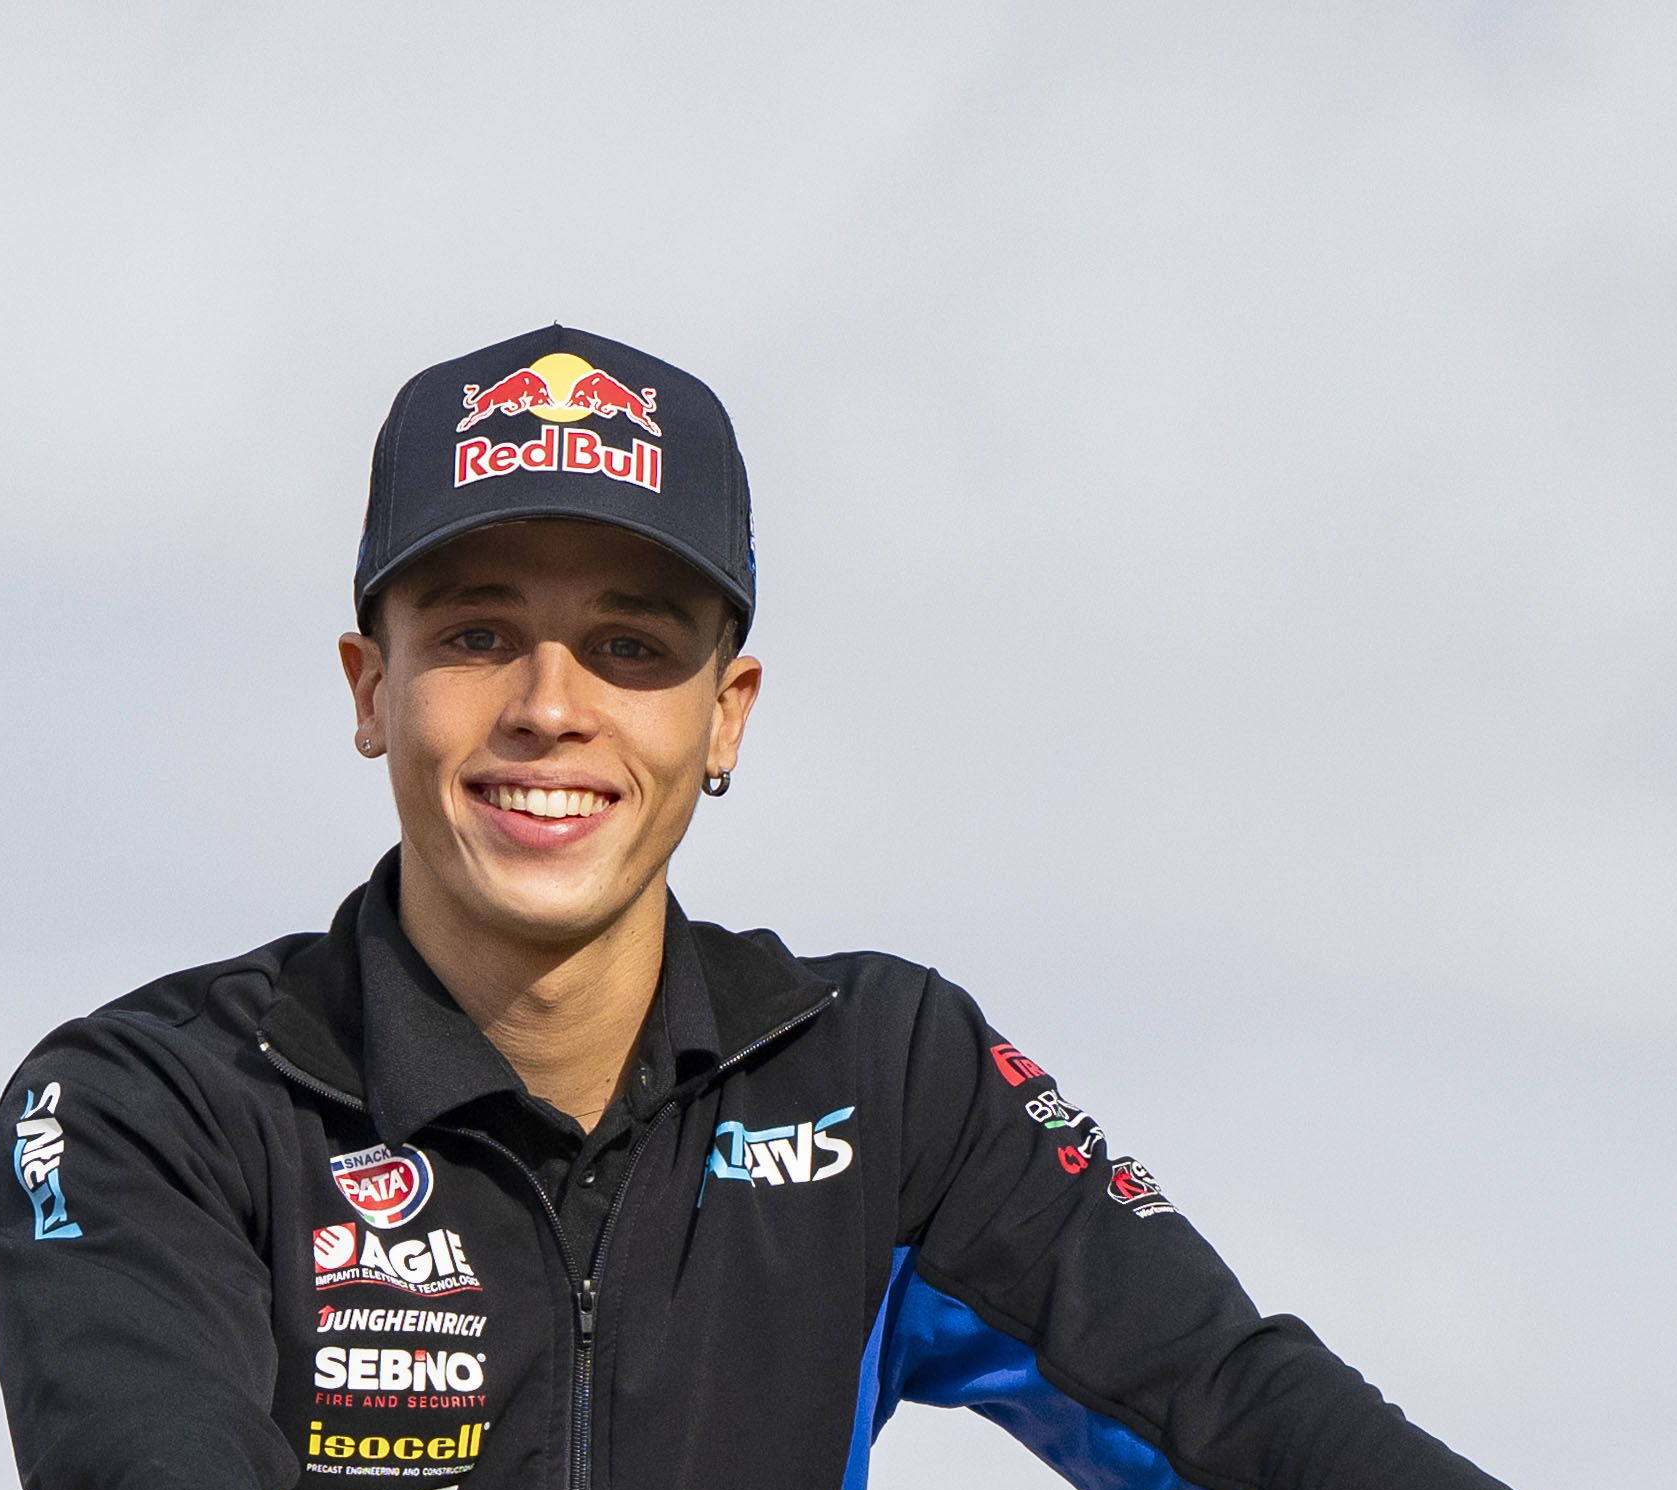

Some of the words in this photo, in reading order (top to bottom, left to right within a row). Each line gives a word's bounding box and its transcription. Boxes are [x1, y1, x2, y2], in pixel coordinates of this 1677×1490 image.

[454, 425, 559, 488] Red
[562, 427, 663, 493] Bull
[338, 1168, 409, 1202] PATA
[359, 1228, 475, 1284] AGIE
[315, 1268, 360, 1286] IMPIANTI
[317, 1305, 487, 1338] JUNGHEINRICH
[315, 1392, 353, 1407] FIRE
[362, 1395, 398, 1408] AND
[407, 1395, 487, 1408] SECURITY
[308, 1420, 483, 1460] isocell
[306, 1463, 342, 1475] PRECAST
[345, 1465, 400, 1476] ENGINEERING
[402, 1467, 420, 1476] AND
